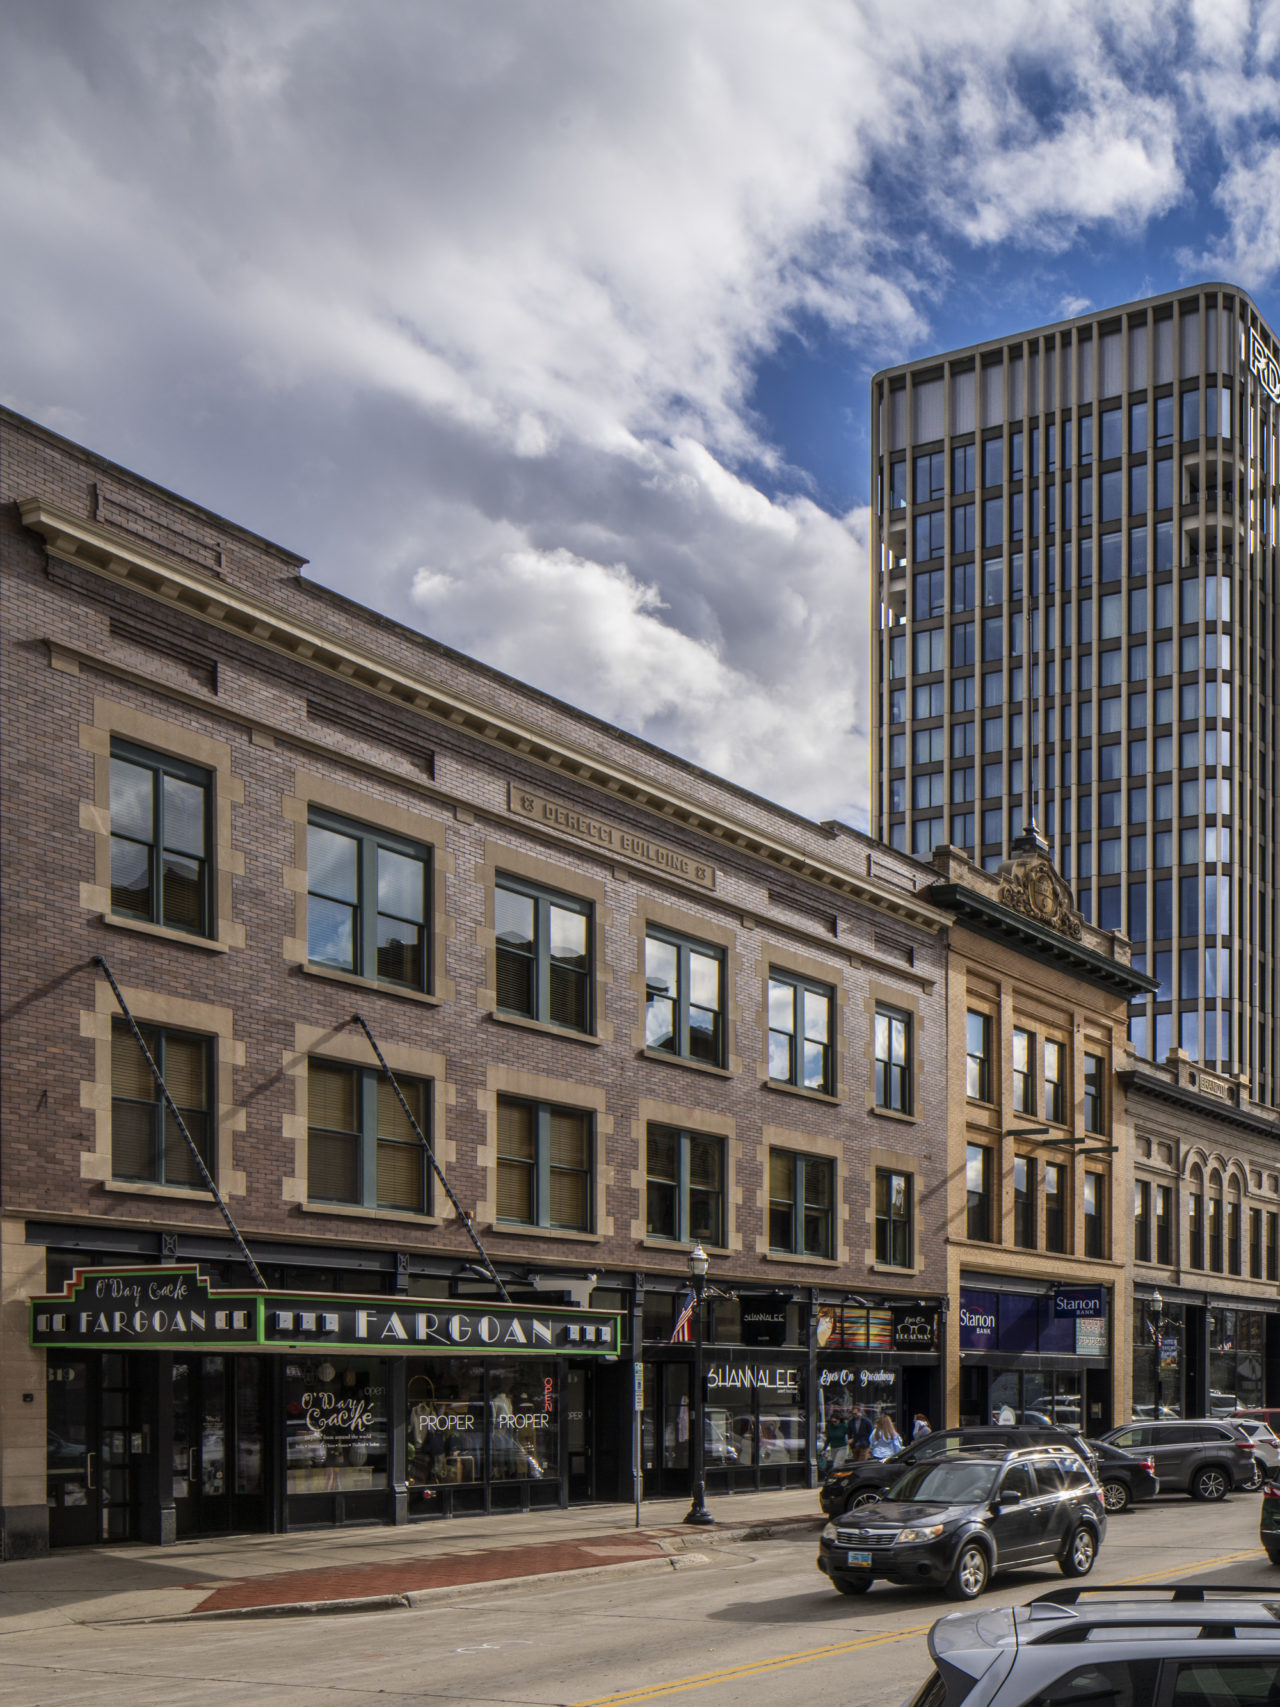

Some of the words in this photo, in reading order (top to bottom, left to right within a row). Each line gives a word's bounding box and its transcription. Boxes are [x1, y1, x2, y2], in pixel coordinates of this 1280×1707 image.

[621, 834, 689, 874] BUILDING
[96, 1278, 141, 1307] O'Day
[1056, 1296, 1100, 1310] Starion
[79, 1310, 206, 1336] FARGOAN
[355, 1309, 552, 1344] FARGOAN
[960, 1309, 995, 1327] Starion
[976, 1327, 991, 1335] BANK
[301, 1392, 358, 1418] O'Day
[544, 1377, 553, 1412] OPEN
[419, 1414, 475, 1431] PROPER
[499, 1413, 549, 1429] PROPER
